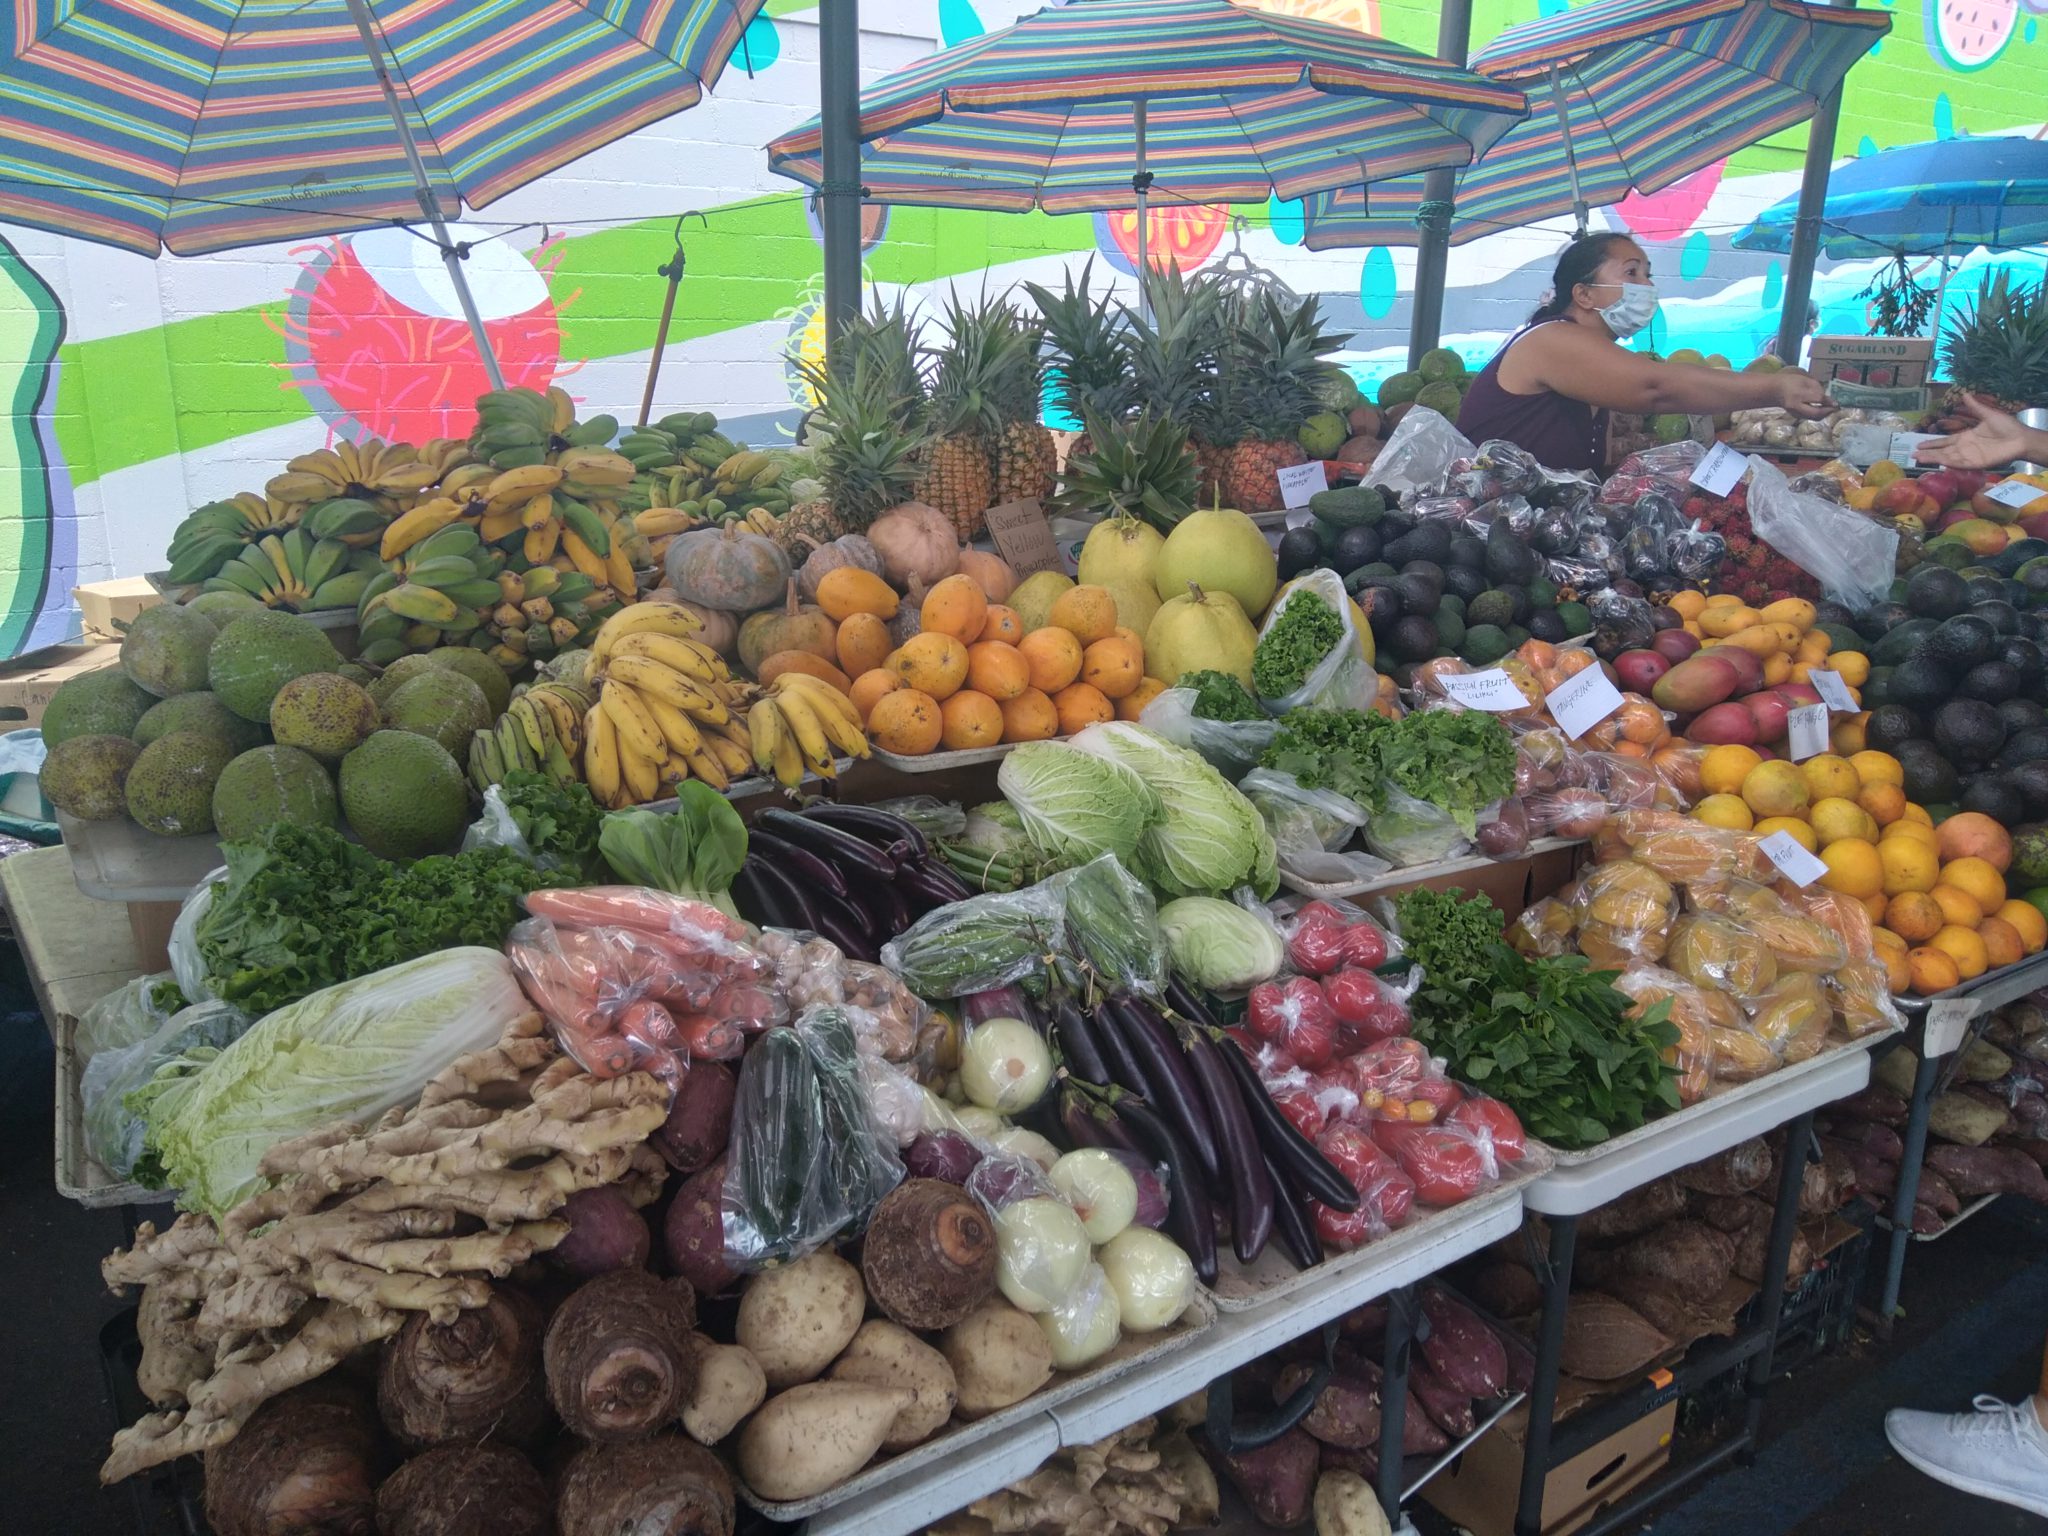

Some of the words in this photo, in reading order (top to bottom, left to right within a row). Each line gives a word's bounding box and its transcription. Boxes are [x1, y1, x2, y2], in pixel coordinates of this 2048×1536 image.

[1828, 343, 1907, 356] SUGARLAND
[994, 507, 1032, 530] Sweet
[1003, 532, 1045, 557] Yellow
[1479, 677, 1509, 690] FRUIT
